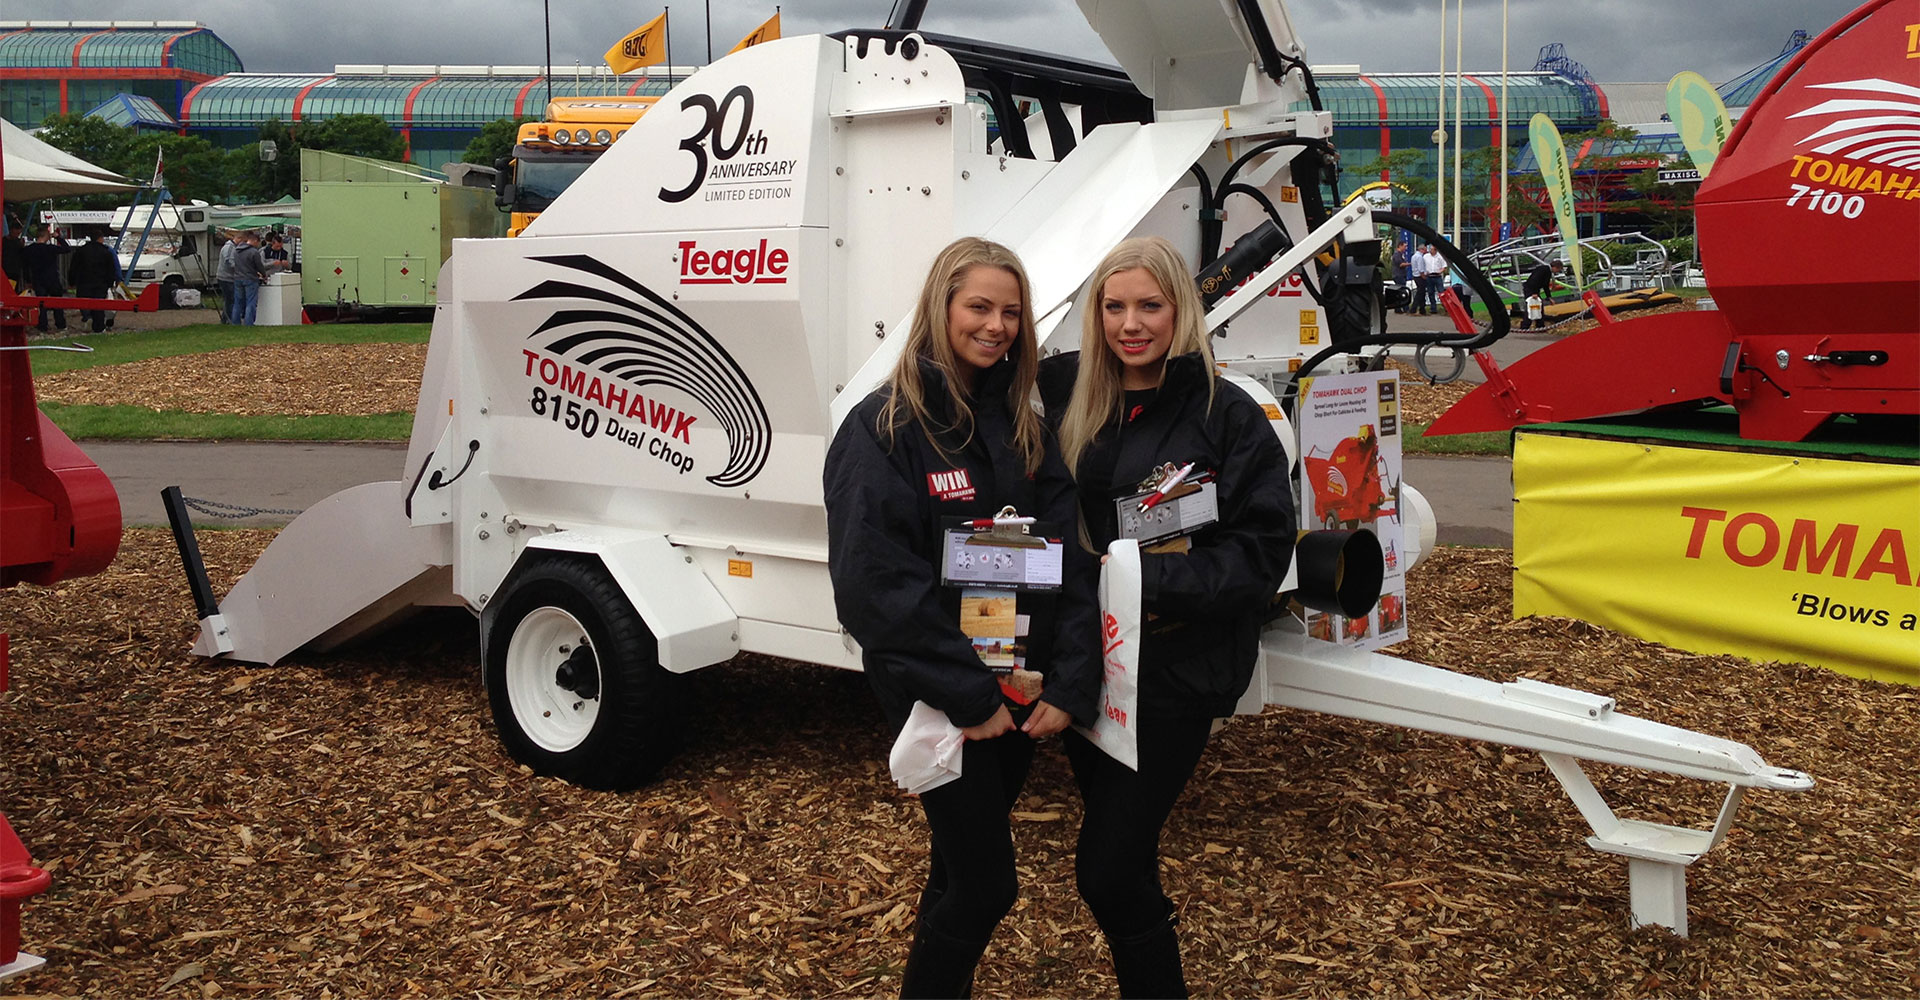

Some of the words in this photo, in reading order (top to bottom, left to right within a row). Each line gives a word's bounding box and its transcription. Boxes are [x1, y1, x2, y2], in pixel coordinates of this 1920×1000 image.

[709, 160, 796, 179] ANNIVERSARY
[1665, 170, 1701, 179] MAXISC
[705, 190, 745, 202] LIMITED
[748, 187, 791, 200] EDITION
[1786, 184, 1865, 219] 7100
[679, 239, 789, 284] Teagle
[522, 349, 698, 445] TOMAHAWK
[1312, 389, 1340, 399] TOMAHAWK
[1340, 387, 1352, 396] DUAL
[1353, 386, 1367, 394] CHOP
[531, 386, 600, 439] 8150
[605, 417, 646, 449] Dual
[648, 437, 694, 475] Chop
[931, 470, 969, 492] WIN
[948, 488, 976, 498] TOMAHAWK
[1681, 506, 1920, 587] TOMA
